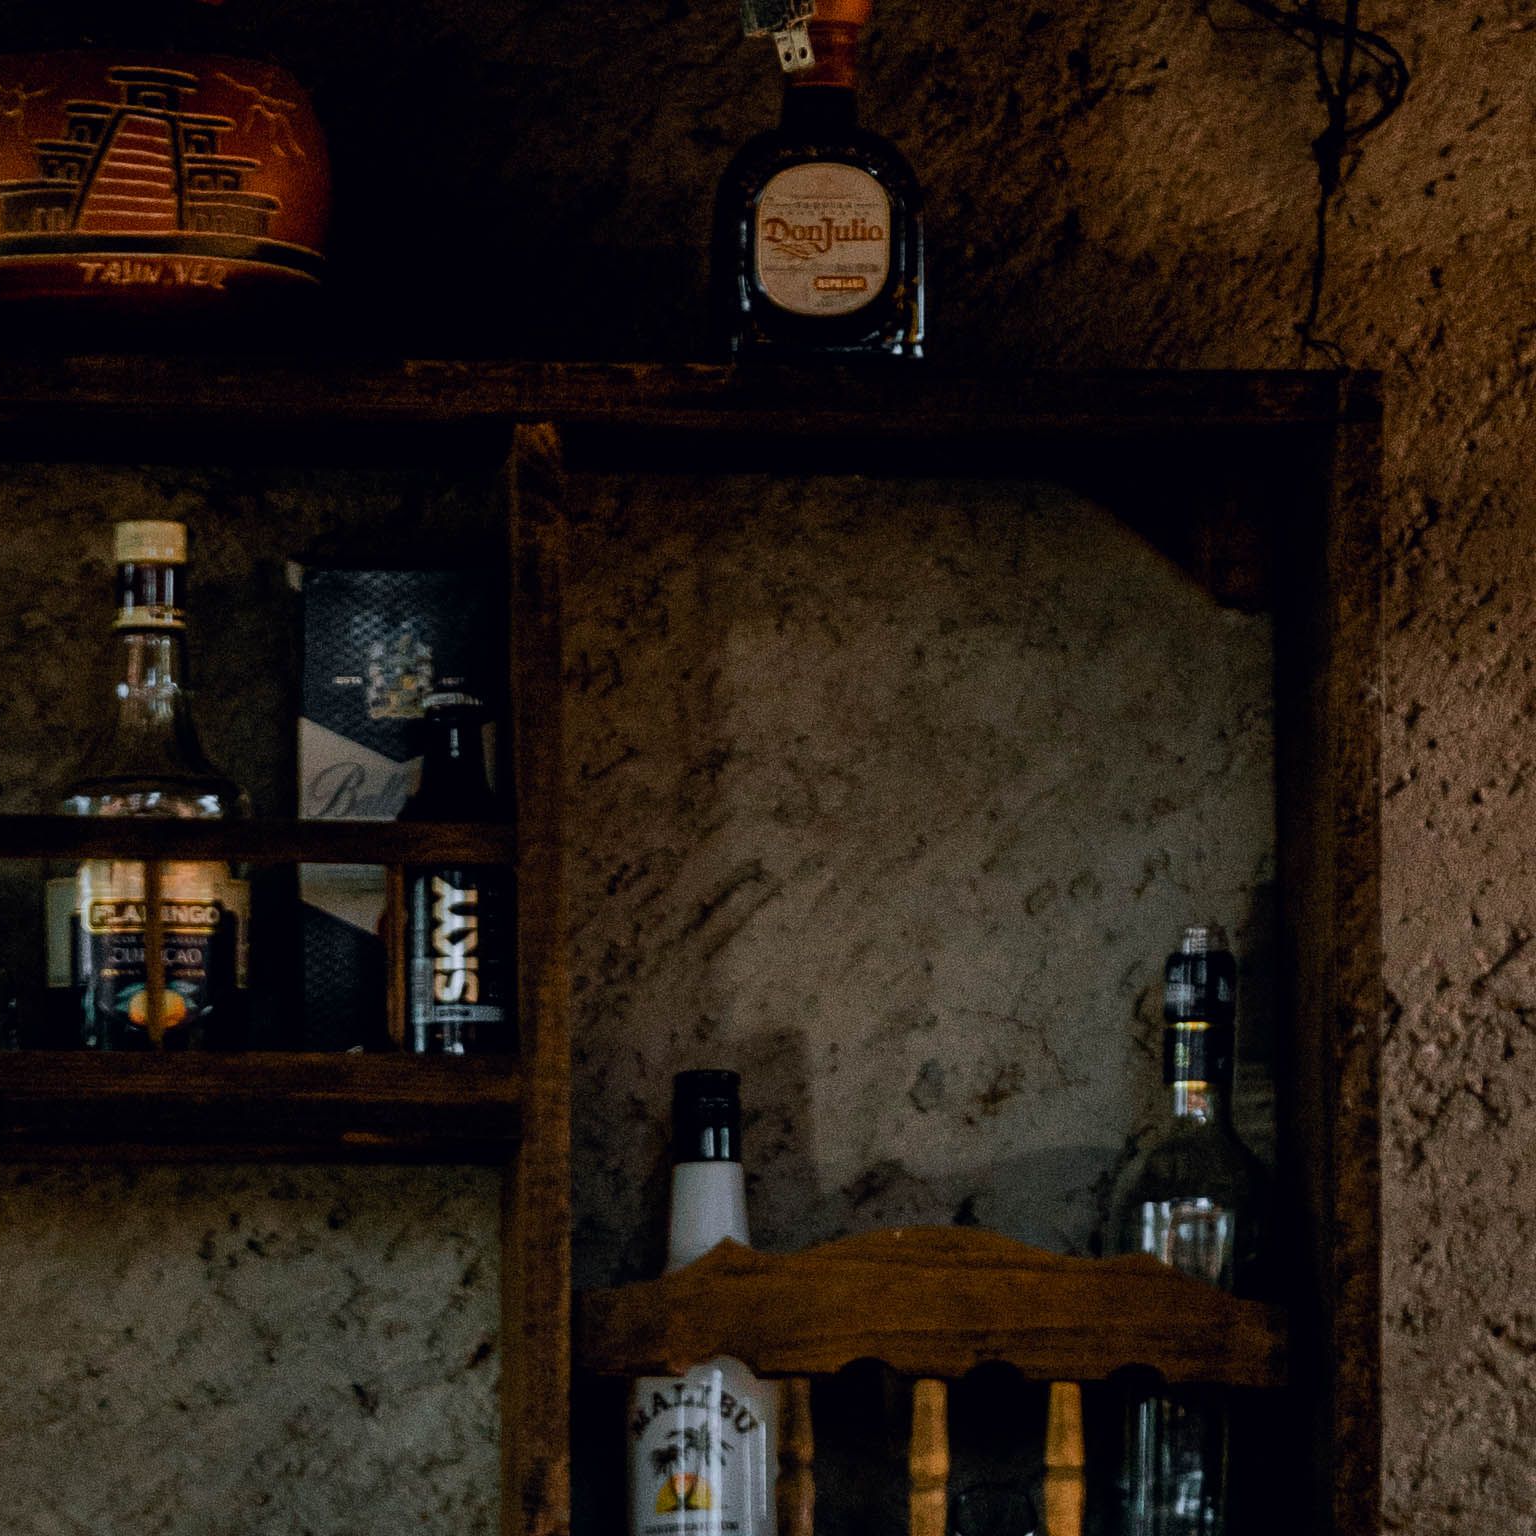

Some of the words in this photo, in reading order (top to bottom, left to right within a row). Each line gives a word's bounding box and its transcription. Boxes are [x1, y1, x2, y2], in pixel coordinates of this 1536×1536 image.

[763, 218, 823, 243] Don
[819, 218, 883, 253] Julio
[431, 875, 480, 1004] SKYY
[632, 1381, 759, 1436] MALIBU
